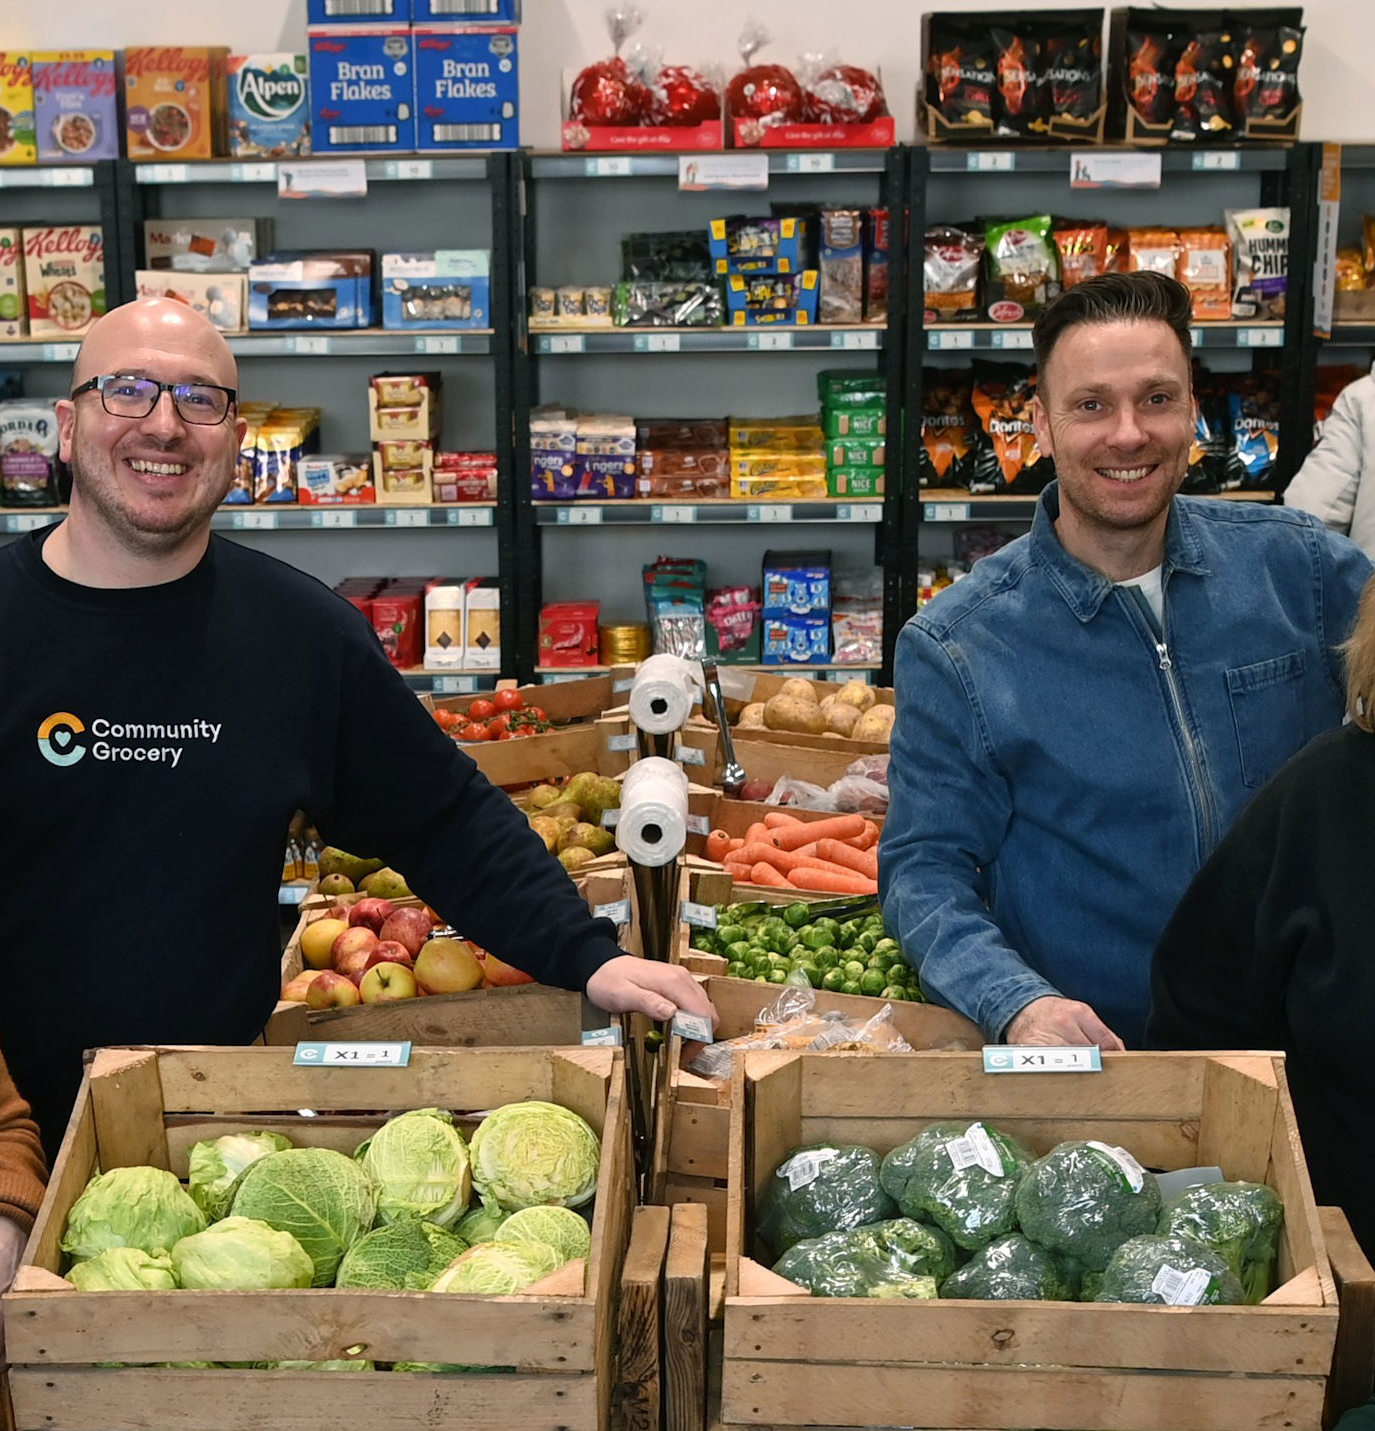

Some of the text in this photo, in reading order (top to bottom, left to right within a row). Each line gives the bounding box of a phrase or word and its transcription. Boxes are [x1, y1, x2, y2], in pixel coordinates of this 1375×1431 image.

[337, 61, 385, 81] Bran
[442, 59, 490, 79] Bran
[942, 65, 995, 83] SENSATION
[241, 70, 300, 97] Alpen
[330, 81, 393, 101] Flakes
[435, 79, 497, 99] Flakes
[1249, 238, 1288, 254] HUMM
[1251, 254, 1288, 275] CHIP
[853, 420, 873, 430] NICE
[848, 451, 868, 461] NICE
[851, 478, 871, 489] NICE
[91, 718, 222, 744] Community
[92, 741, 183, 768] Grocery
[335, 1050, 360, 1060] X1
[1021, 1055, 1045, 1065] X1
